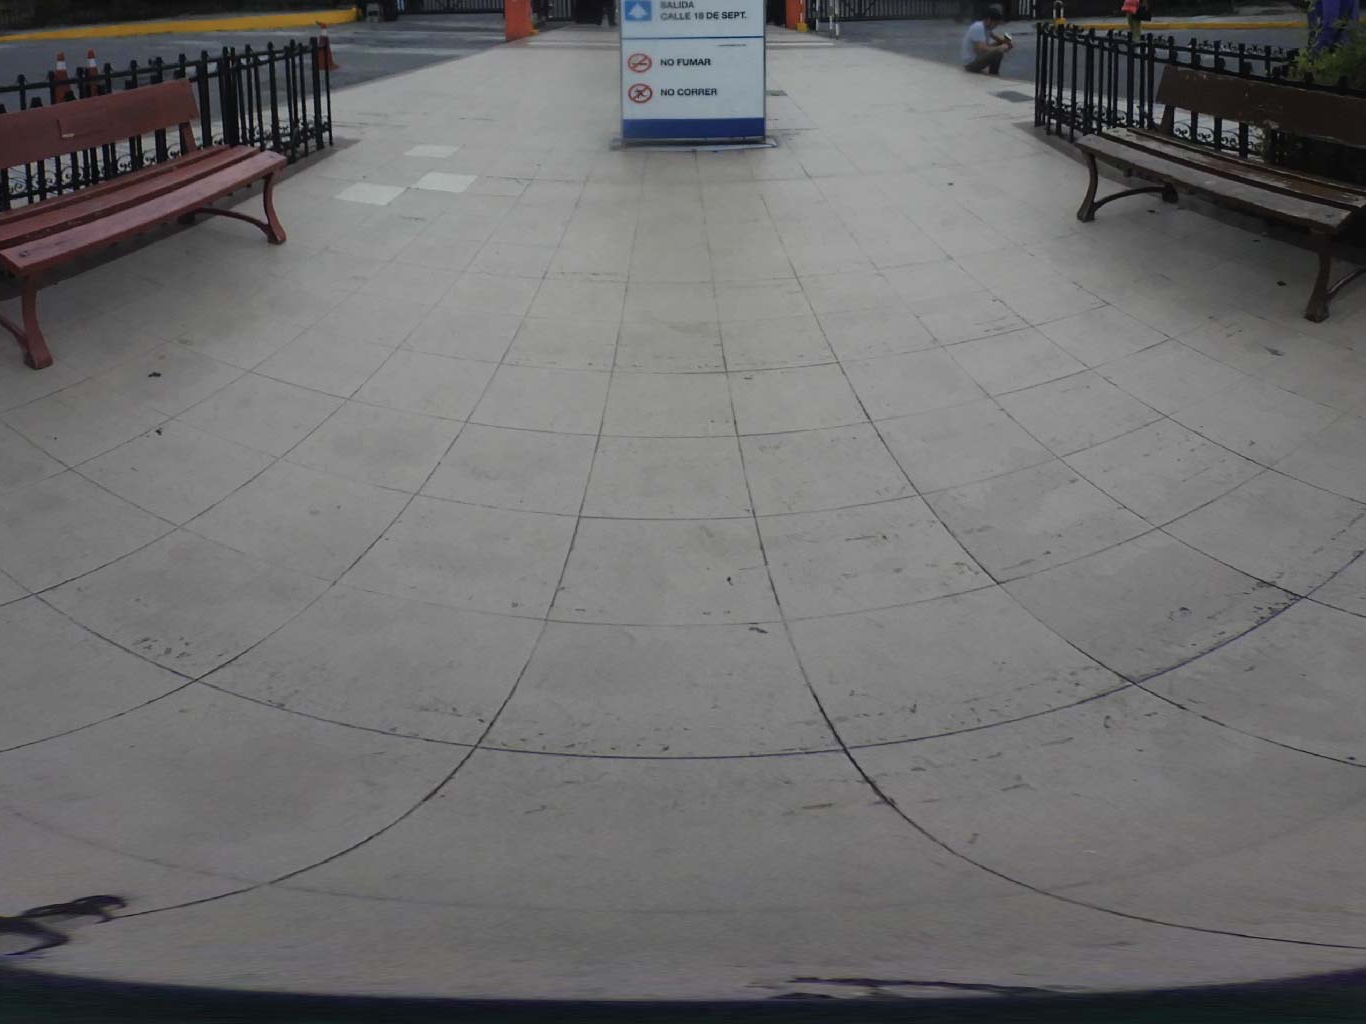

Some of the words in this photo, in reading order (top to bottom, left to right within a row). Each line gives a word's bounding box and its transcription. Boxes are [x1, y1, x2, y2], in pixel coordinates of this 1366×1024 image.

[660, 1, 695, 9] SALIDA
[660, 12, 691, 21] CALLE
[694, 12, 705, 20] 18
[706, 12, 719, 20] DE
[721, 11, 747, 19] SEPT.
[660, 58, 675, 66] NO
[677, 58, 712, 66] FUMAR
[660, 88, 675, 96] NO
[677, 88, 718, 96] CORRER
